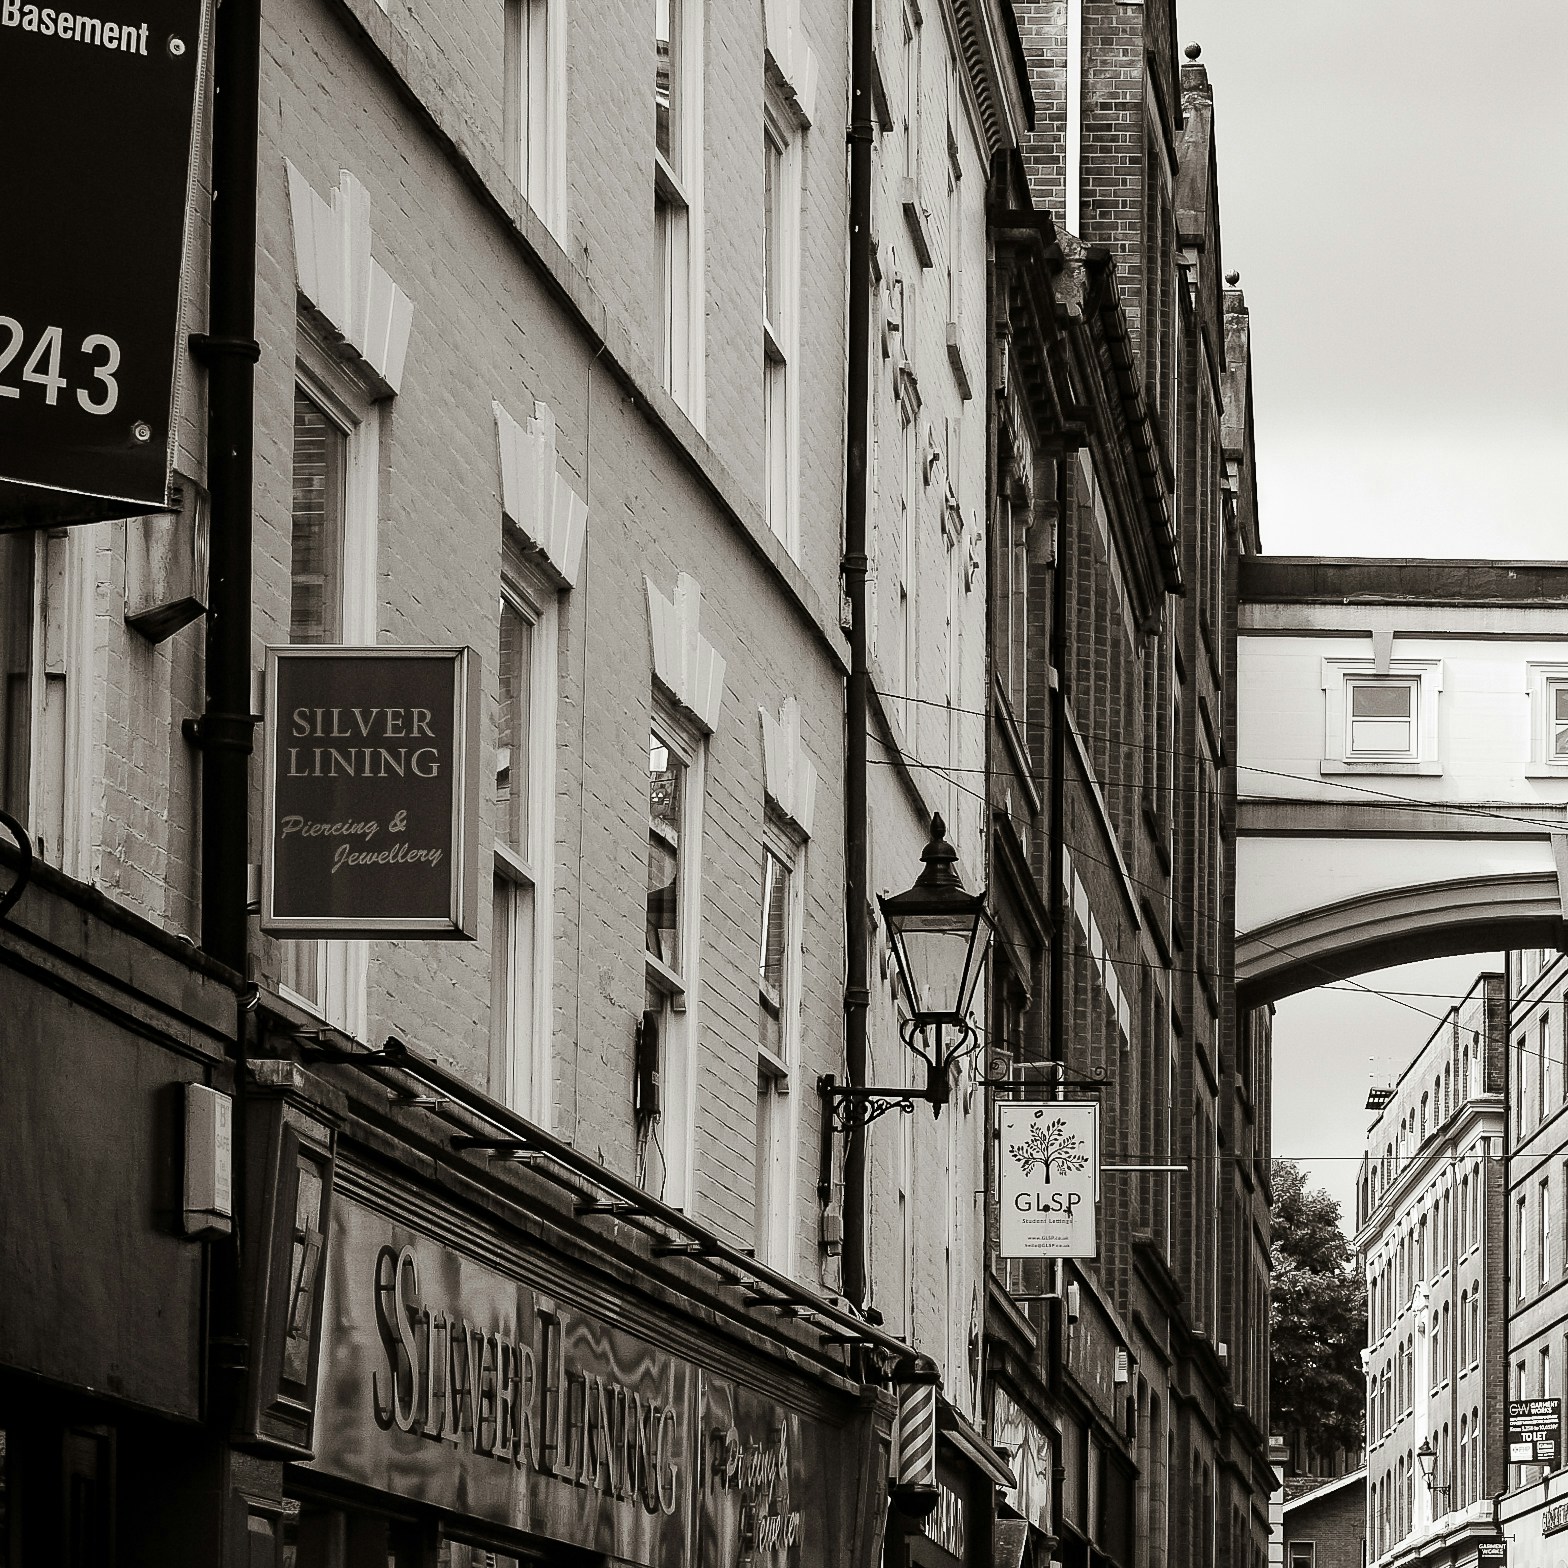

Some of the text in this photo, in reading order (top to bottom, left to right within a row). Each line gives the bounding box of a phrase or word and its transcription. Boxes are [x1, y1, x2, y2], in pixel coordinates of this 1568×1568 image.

[292, 707, 436, 738] SILVER
[286, 747, 441, 778] LINING
[281, 809, 408, 841] Piercing &
[331, 842, 444, 874] Jewellery
[1015, 1192, 1082, 1213] GLSP
[393, 1244, 678, 1517] SILVER LINING
[1521, 1431, 1548, 1442] TO LET
